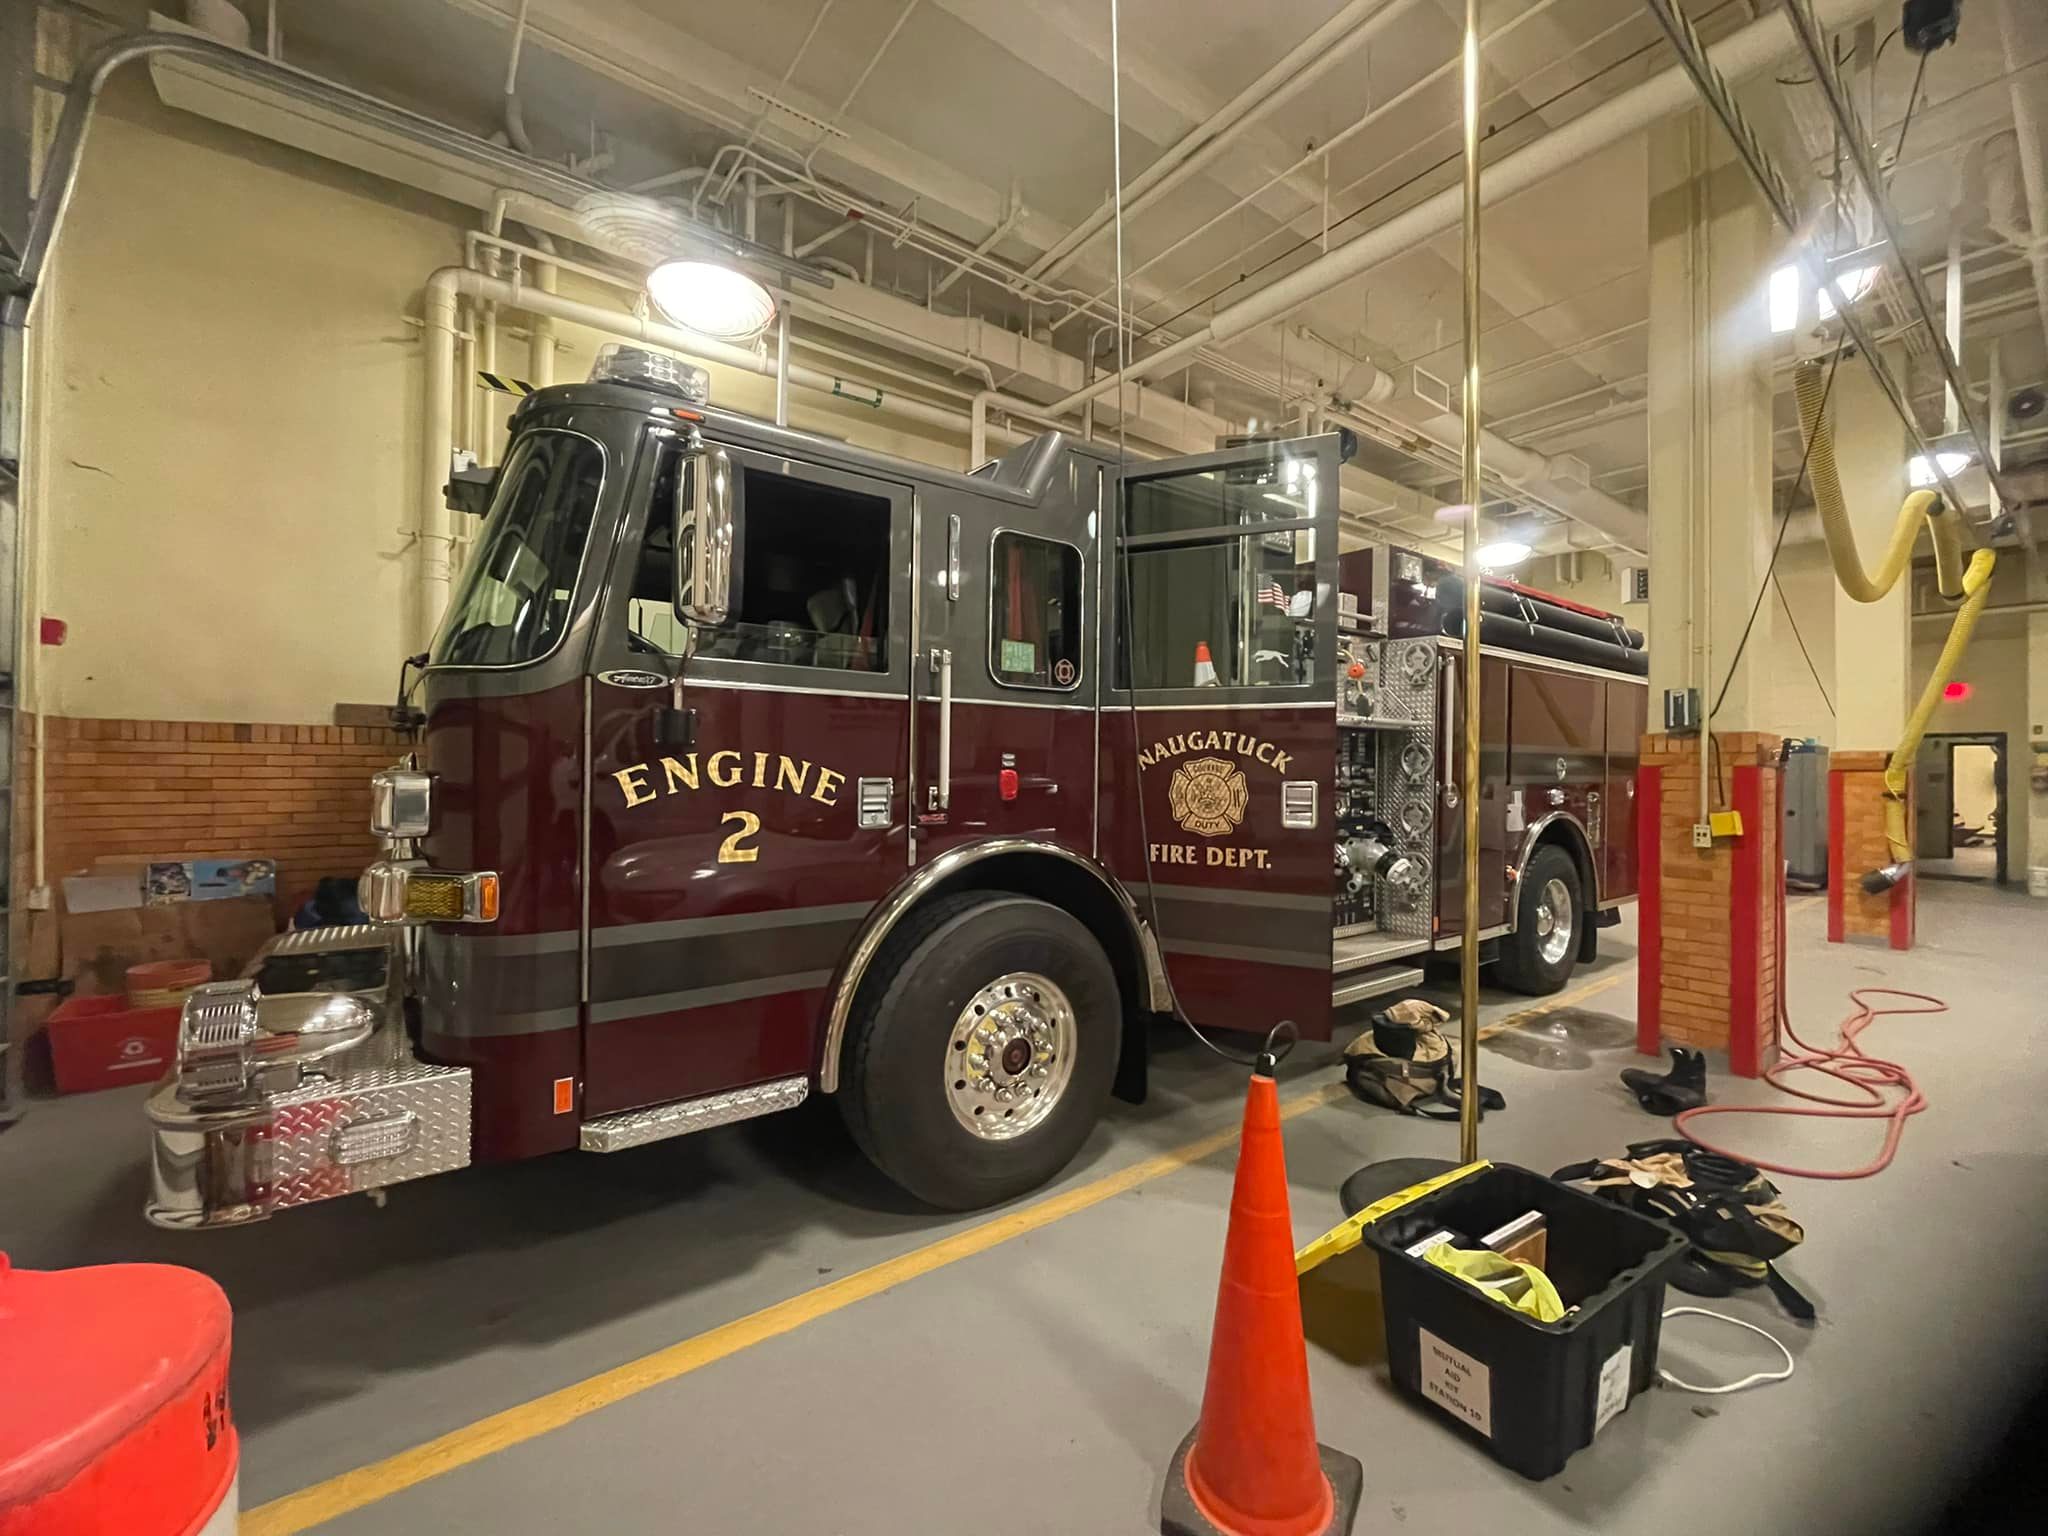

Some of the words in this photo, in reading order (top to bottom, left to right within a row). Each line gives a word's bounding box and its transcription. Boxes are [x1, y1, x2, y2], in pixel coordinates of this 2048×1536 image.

[1138, 731, 1293, 774] NAUGATUCK
[613, 751, 846, 808] ENGINE
[718, 811, 760, 863] 2
[1195, 821, 1221, 830] DUTY
[1150, 844, 1197, 865] FIRE
[1206, 846, 1272, 869] DEPT.
[1432, 1346, 1472, 1377] MUTUAL
[1444, 1368, 1461, 1383] AID
[1429, 1381, 1467, 1413] STATION
